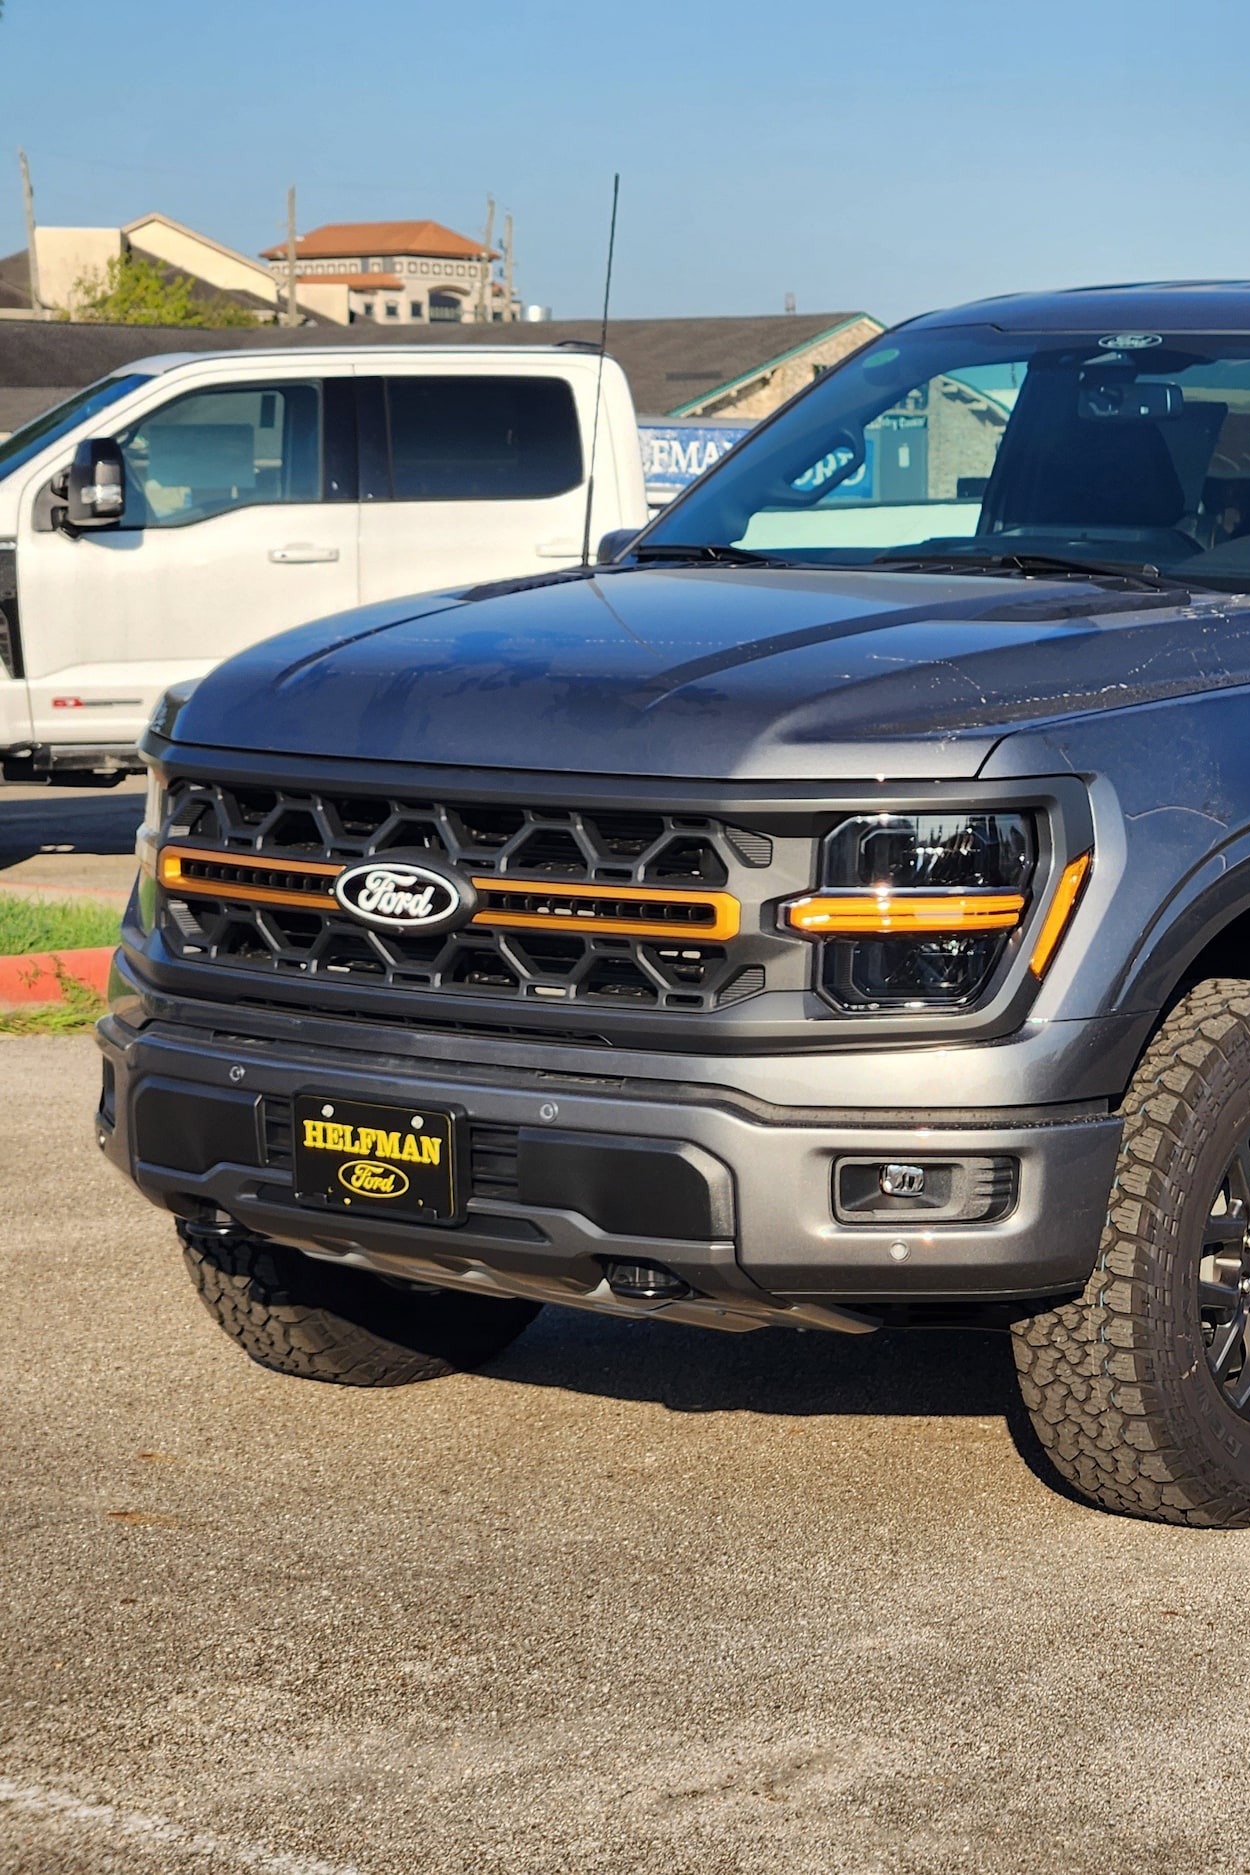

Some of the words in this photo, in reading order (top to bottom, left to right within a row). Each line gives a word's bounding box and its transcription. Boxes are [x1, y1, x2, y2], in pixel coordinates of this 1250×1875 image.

[643, 438, 734, 475] FMA
[357, 870, 436, 918] Ford
[303, 1120, 442, 1166] HELFMAN
[351, 1164, 396, 1193] Ford
